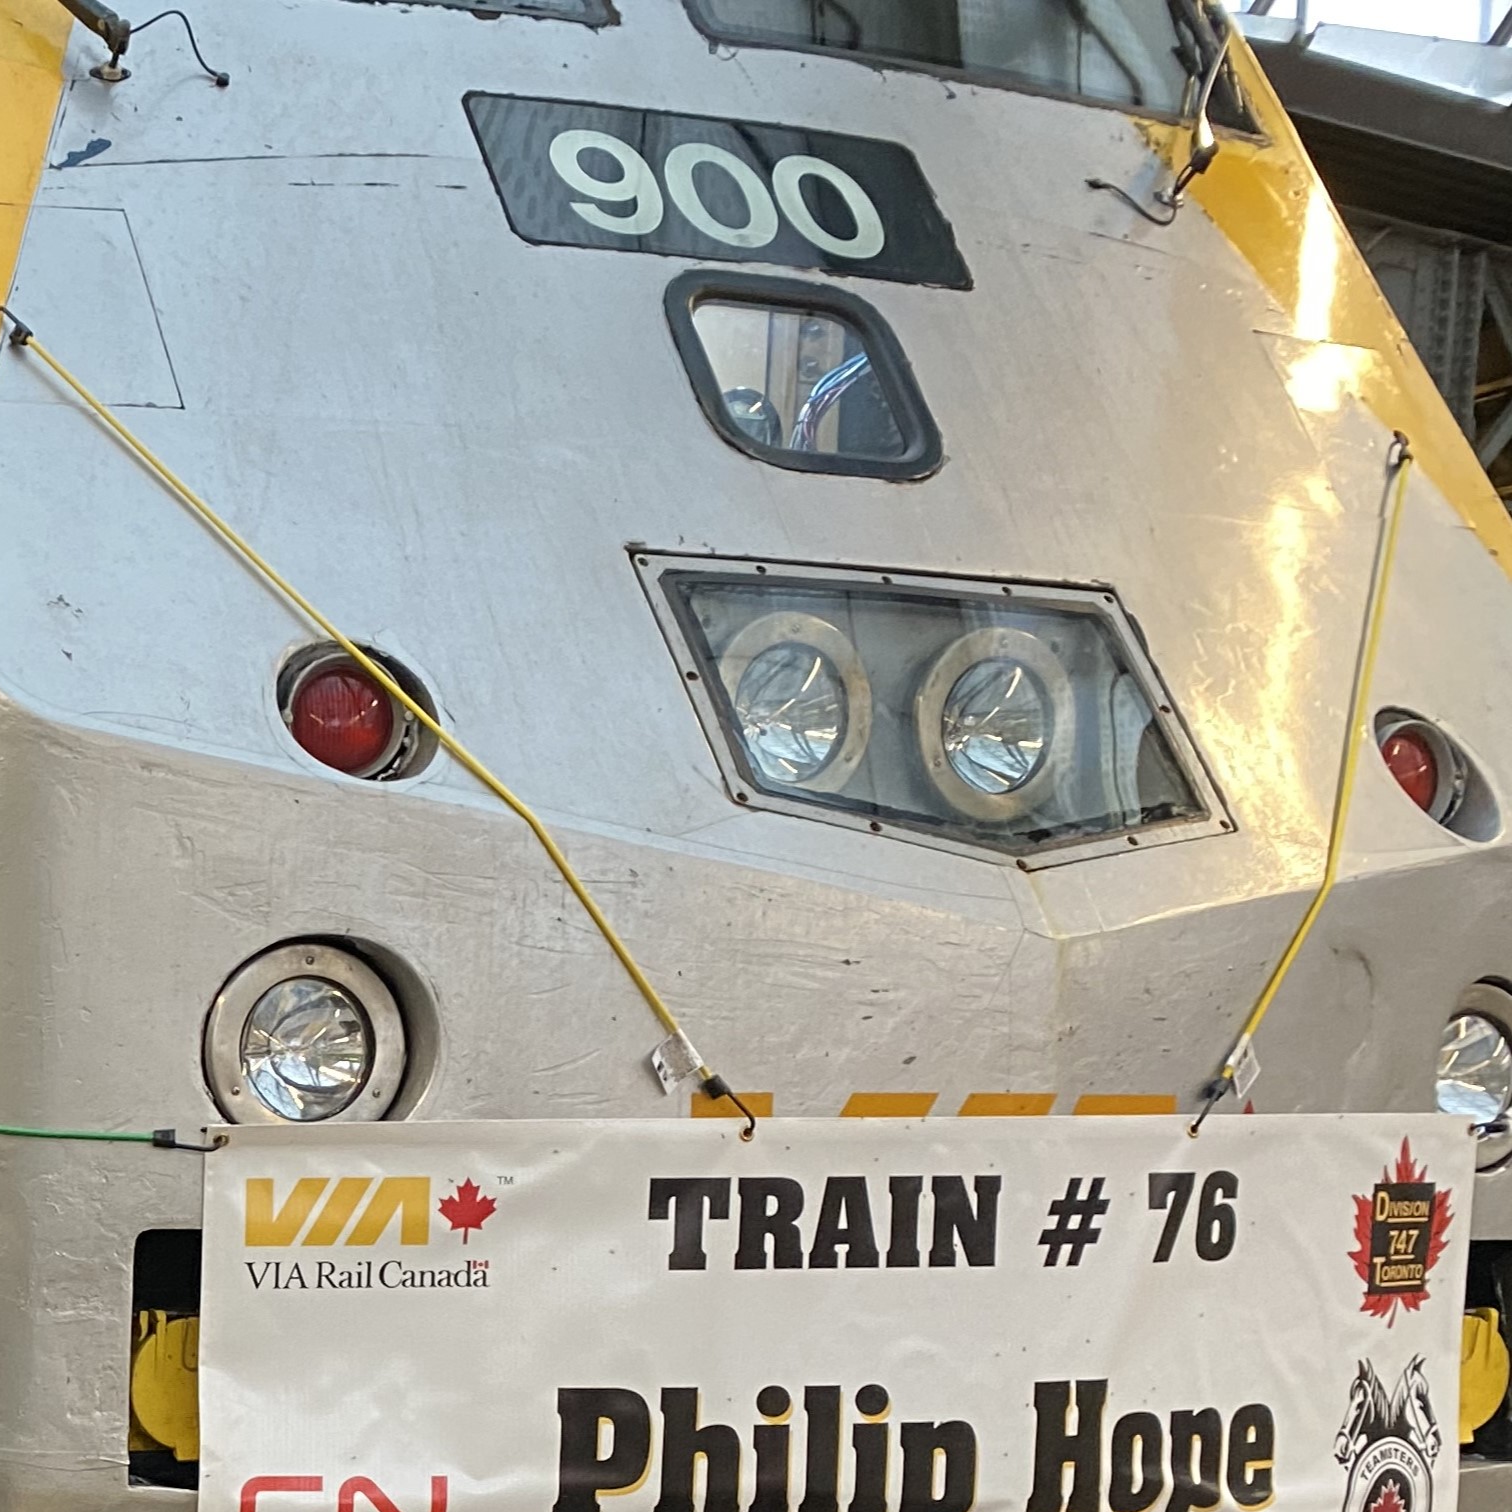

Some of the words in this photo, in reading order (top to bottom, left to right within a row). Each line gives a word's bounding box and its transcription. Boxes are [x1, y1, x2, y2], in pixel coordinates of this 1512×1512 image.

[549, 129, 885, 259] 900
[245, 1177, 431, 1246] VIA
[648, 1175, 1002, 1270] TRAIN
[1037, 1177, 1110, 1267] #
[1148, 1171, 1239, 1263] 76
[1389, 1230, 1420, 1254] 747
[245, 1262, 309, 1289] VIA
[316, 1260, 372, 1288] Rail
[379, 1260, 490, 1288] Canada
[1360, 1447, 1420, 1481] TEAMSTERS
